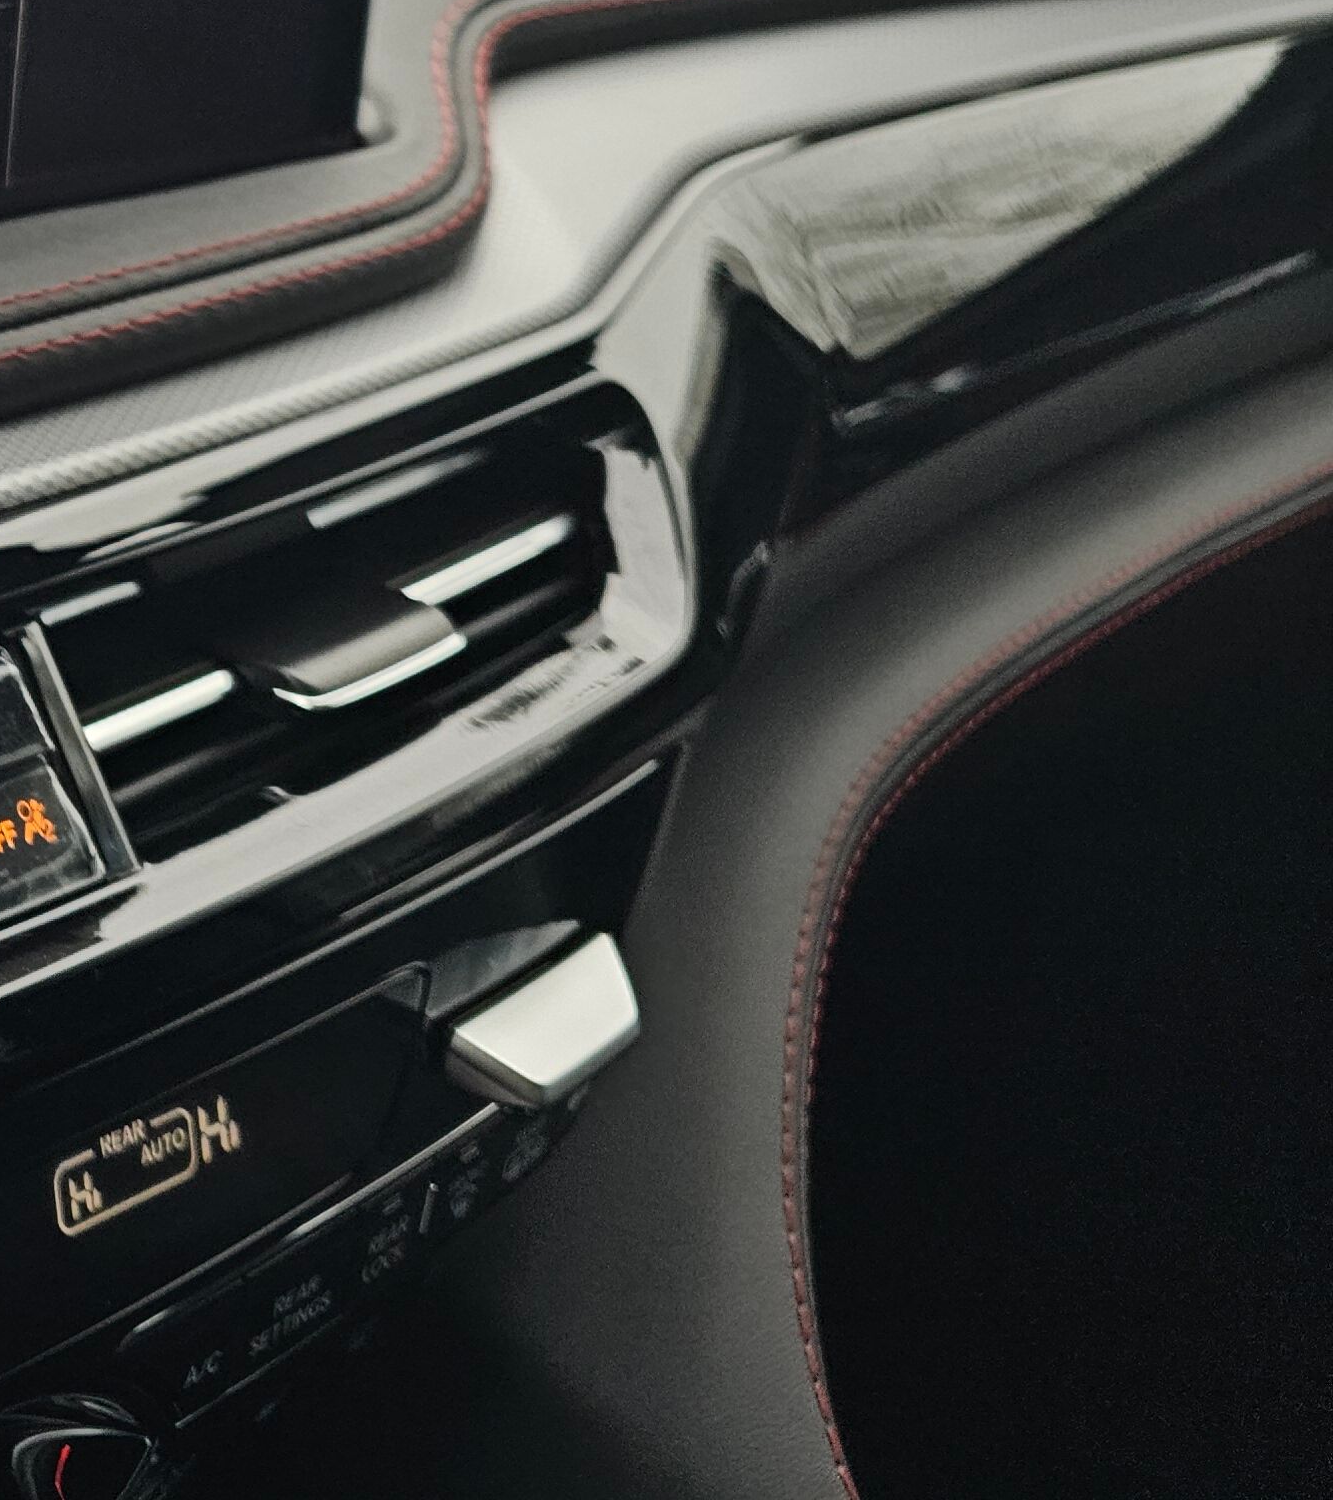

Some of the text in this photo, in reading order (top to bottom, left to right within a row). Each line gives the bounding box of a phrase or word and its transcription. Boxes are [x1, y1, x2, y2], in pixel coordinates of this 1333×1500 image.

[99, 1118, 147, 1158] REAR
[140, 1126, 186, 1166] AUTO
[248, 1292, 332, 1354] SETTINGS
